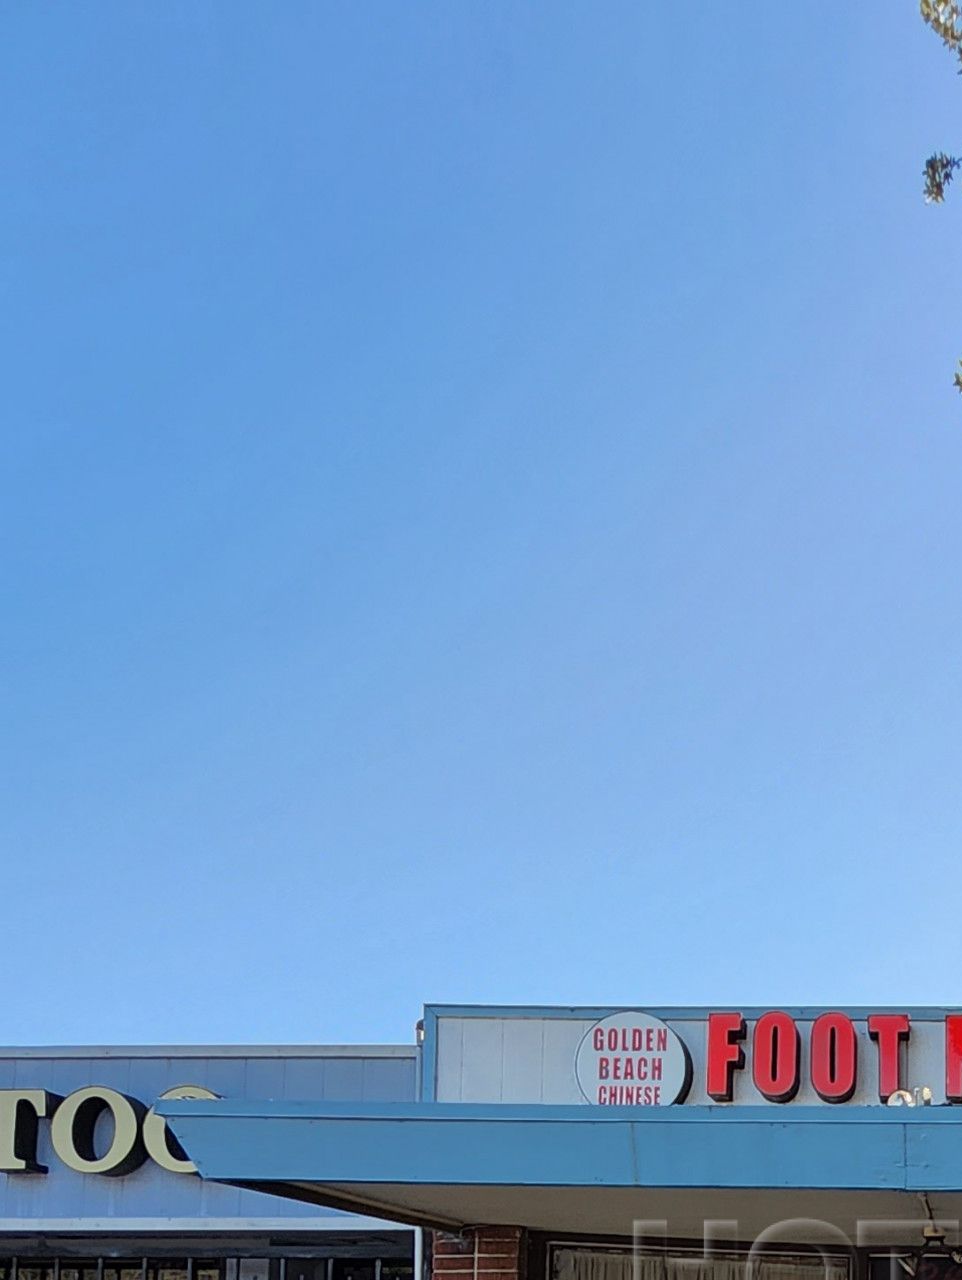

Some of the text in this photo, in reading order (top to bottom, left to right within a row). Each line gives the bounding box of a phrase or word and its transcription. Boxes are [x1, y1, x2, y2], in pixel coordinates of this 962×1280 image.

[593, 1027, 668, 1052] GOLDEN
[706, 1011, 910, 1102] FOOT
[598, 1057, 663, 1081] BEACH
[598, 1085, 661, 1106] CHINESE
